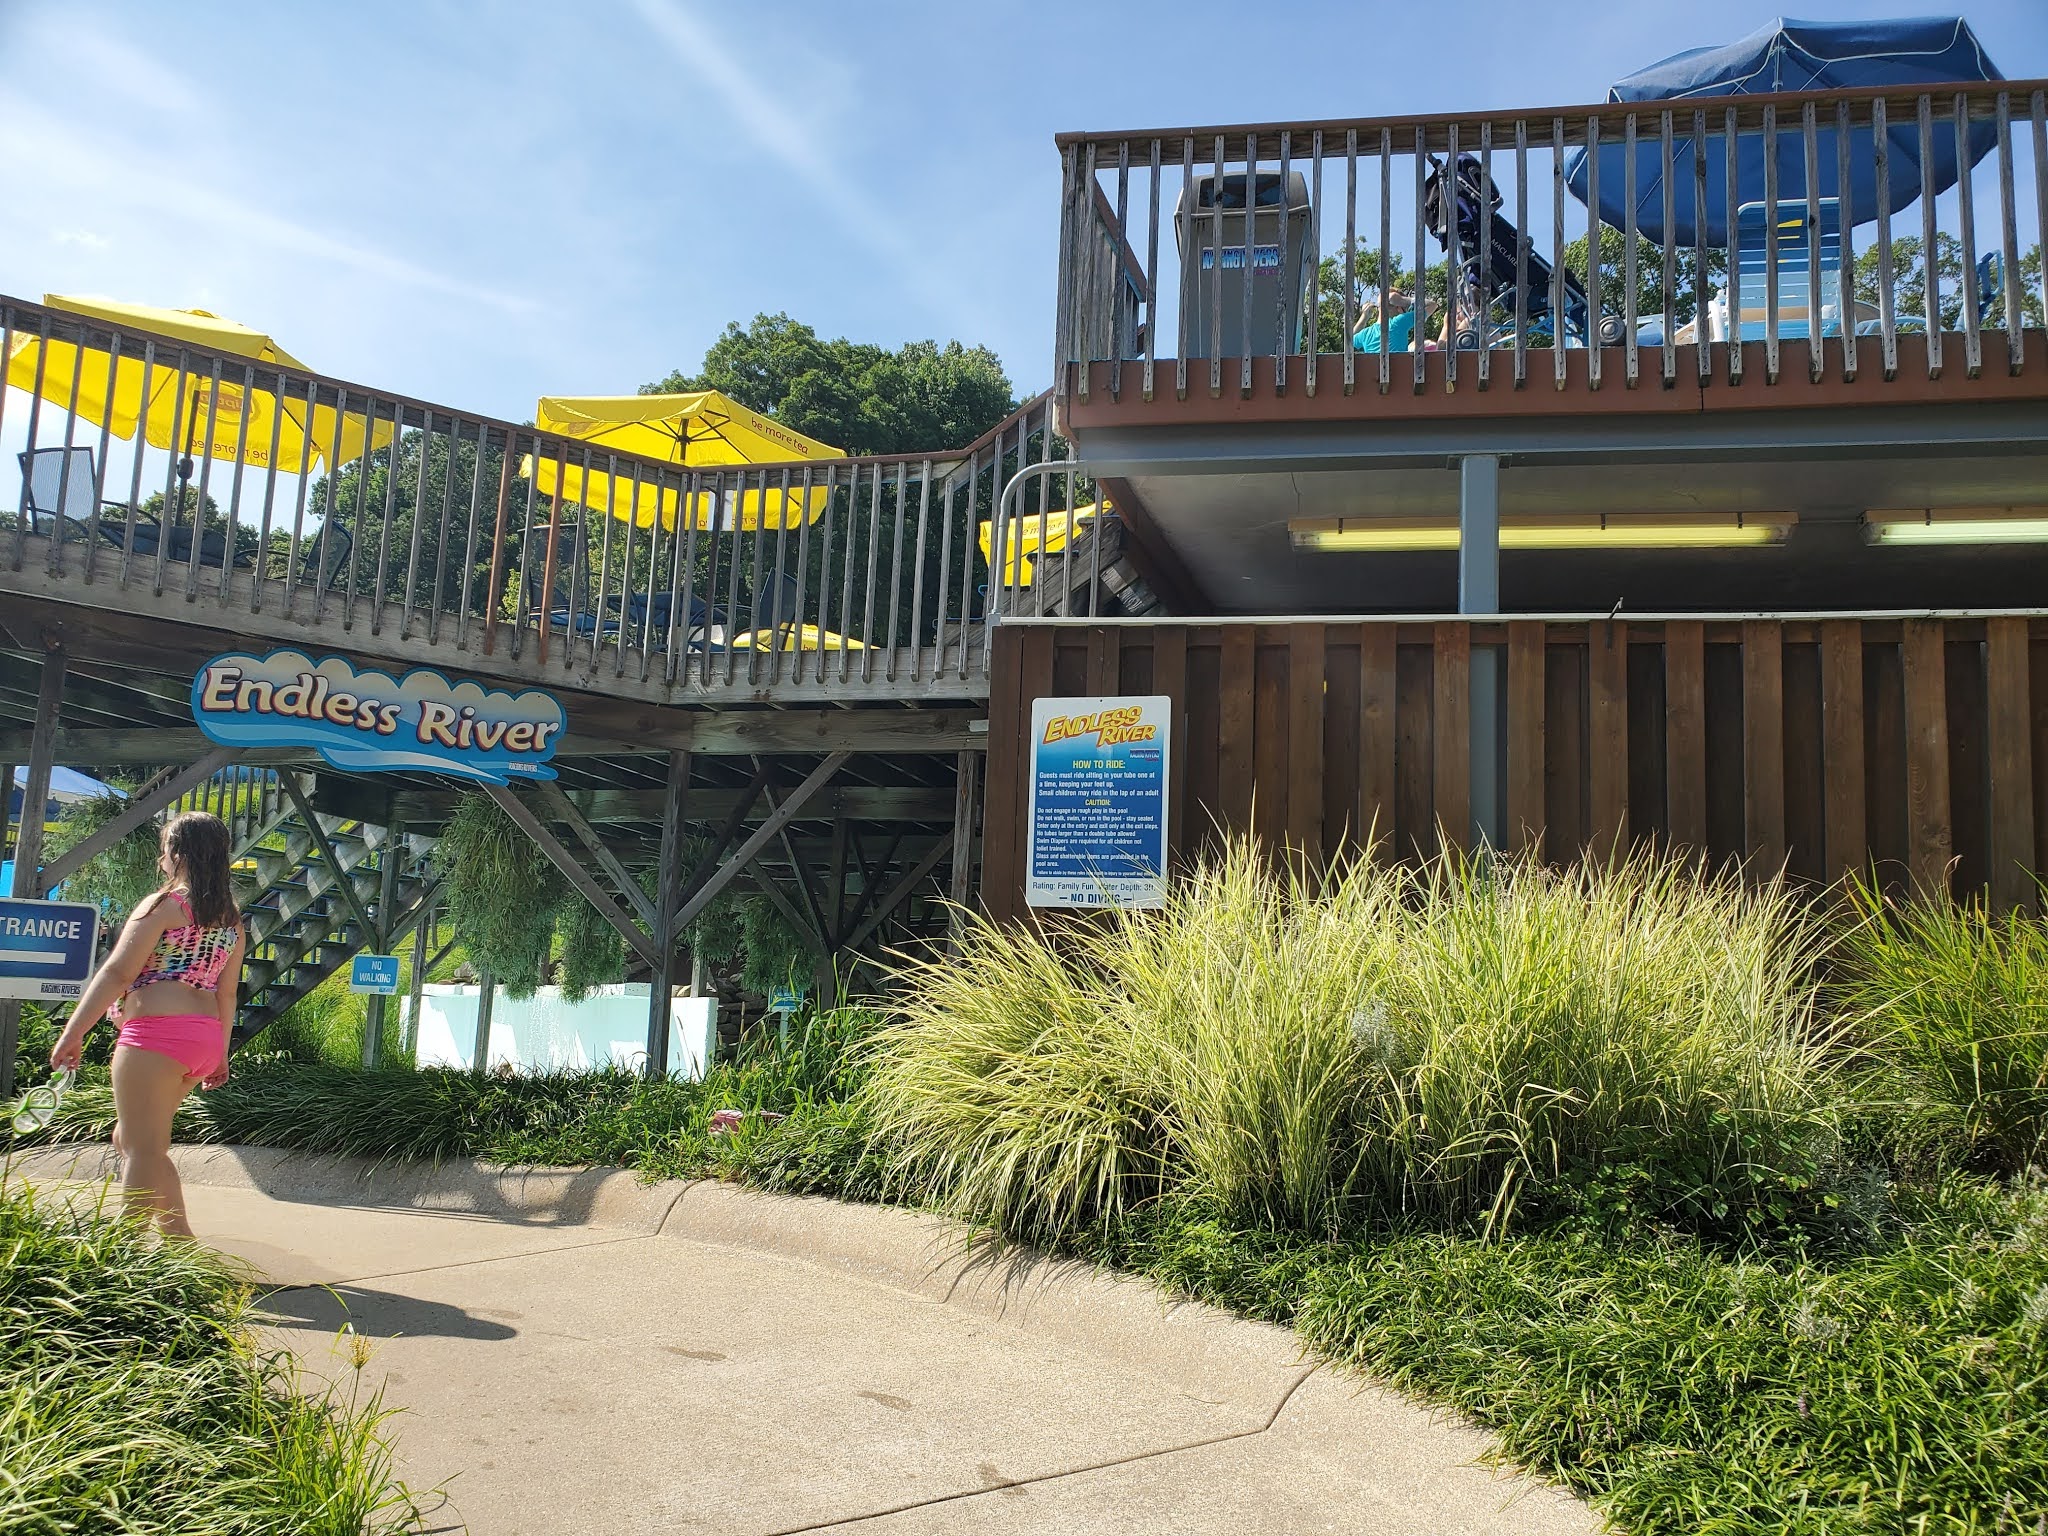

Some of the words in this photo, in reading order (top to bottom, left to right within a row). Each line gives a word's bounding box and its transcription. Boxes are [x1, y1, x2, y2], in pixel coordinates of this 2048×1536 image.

[1203, 249, 1241, 270] RAING
[1491, 238, 1517, 267] MACLARE
[751, 416, 763, 431] be
[765, 426, 792, 444] more
[793, 438, 808, 455] tea
[201, 666, 402, 736] Endless
[416, 699, 560, 751] River
[1043, 705, 1143, 744] ENDLESS
[1096, 725, 1157, 748] RIVER
[1072, 760, 1091, 769] HOW
[1093, 760, 1103, 769] TO
[1105, 760, 1126, 769] RIDE:
[1058, 781, 1079, 789] keeping
[1032, 882, 1056, 890] Rating:
[1057, 882, 1079, 891] Family
[1120, 883, 1142, 892] Depth:
[1070, 894, 1084, 902] NO
[371, 960, 383, 971] NO
[359, 972, 392, 983] WALKING
